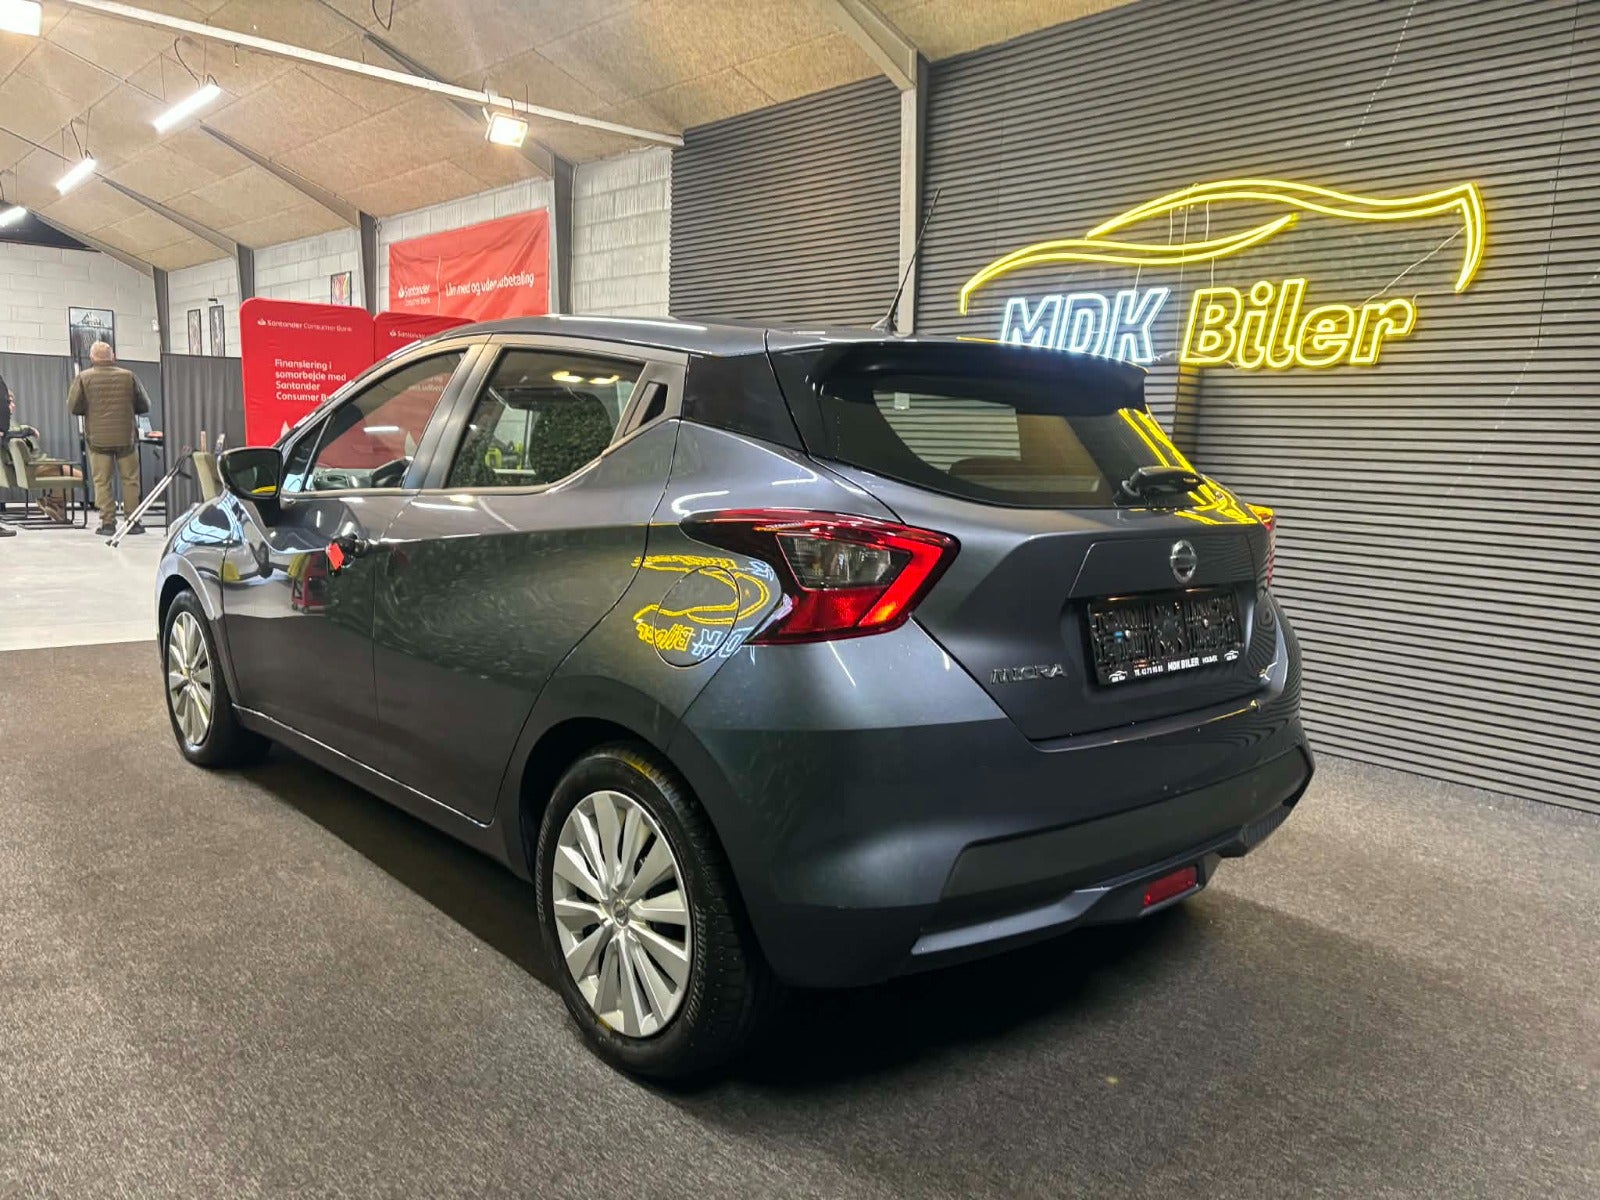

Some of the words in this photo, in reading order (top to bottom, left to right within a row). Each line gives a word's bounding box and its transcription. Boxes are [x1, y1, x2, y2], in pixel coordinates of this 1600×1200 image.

[471, 281, 481, 296] og
[267, 319, 302, 329] Santander
[303, 322, 335, 332] Consumer
[1000, 287, 1171, 363] MDK
[1179, 277, 1416, 369] Biler
[274, 358, 328, 371] Finansiering
[329, 361, 332, 370] i
[275, 370, 326, 382] samarbejde
[327, 373, 347, 382] med
[275, 380, 321, 391] Santander
[276, 391, 320, 402] Consumer
[1180, 657, 1200, 669] BILER
